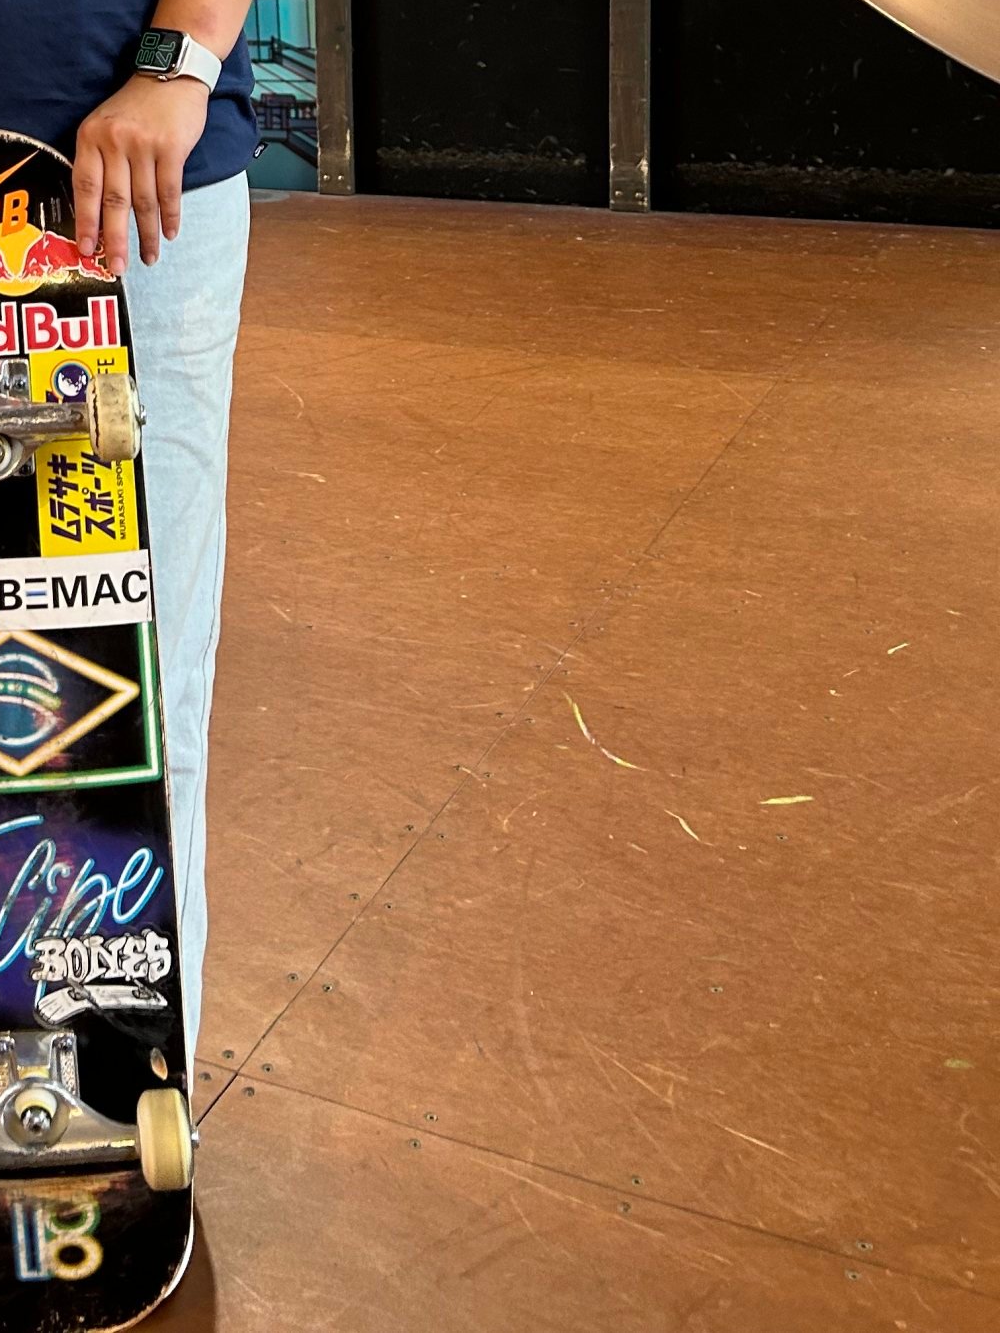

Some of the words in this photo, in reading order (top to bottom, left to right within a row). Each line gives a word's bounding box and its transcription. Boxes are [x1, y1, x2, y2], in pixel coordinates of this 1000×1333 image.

[25, 299, 118, 350] Bull
[47, 453, 82, 543] ムラサキ
[115, 460, 124, 486] SPOR
[117, 490, 126, 540] MURASAKI
[31, 928, 172, 983] BONES
